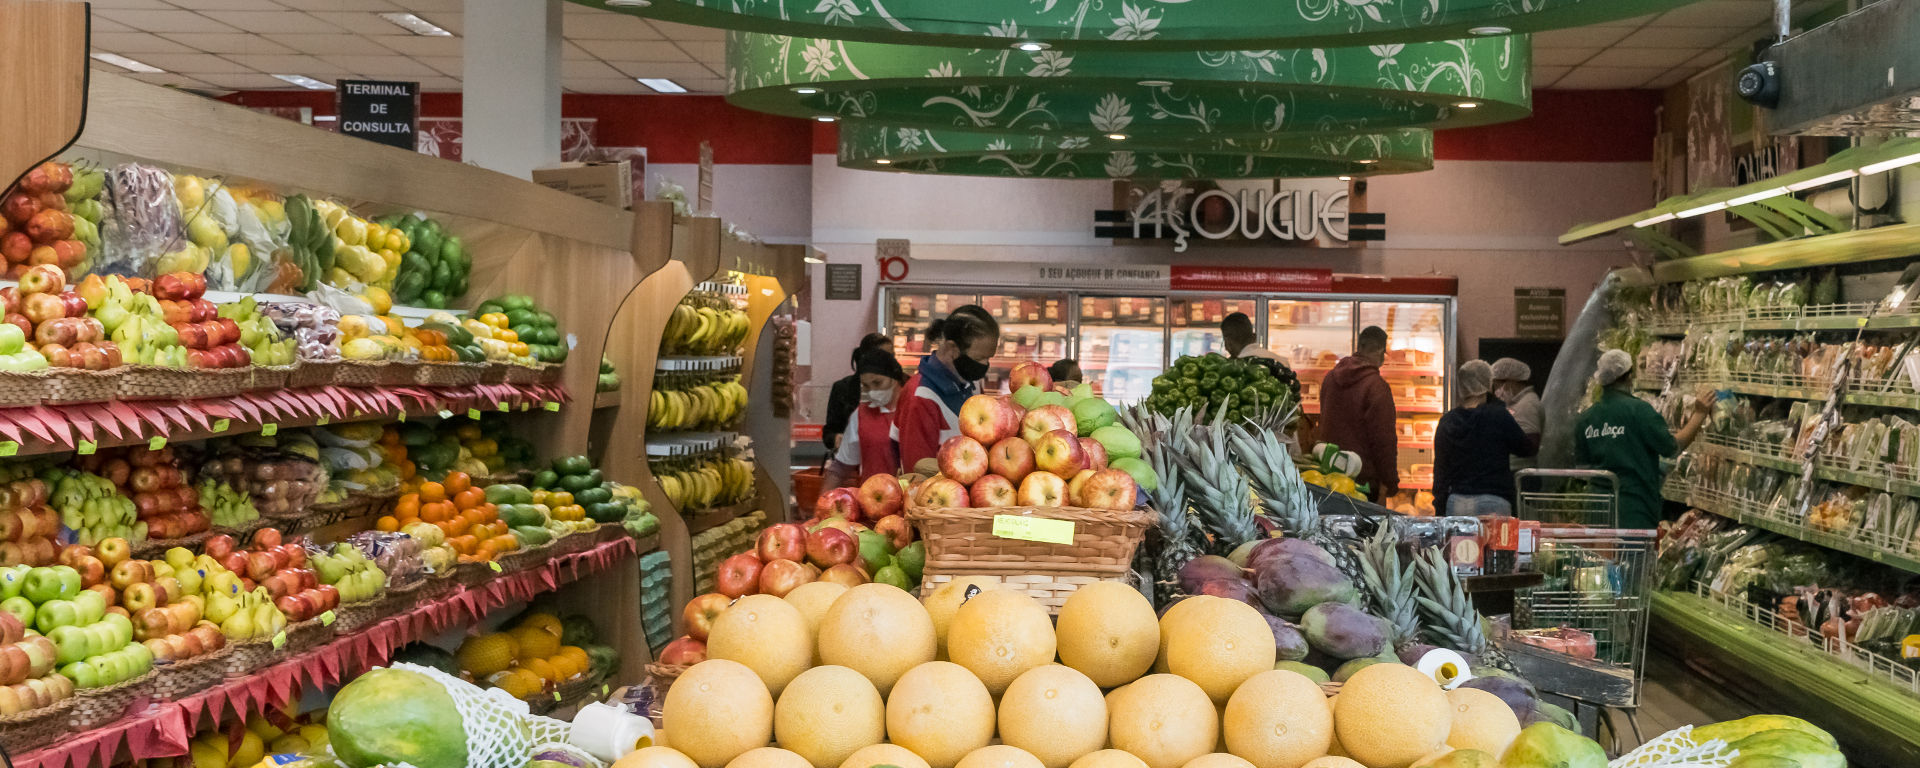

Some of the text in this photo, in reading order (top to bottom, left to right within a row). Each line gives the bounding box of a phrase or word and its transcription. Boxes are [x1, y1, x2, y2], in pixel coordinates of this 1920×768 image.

[345, 84, 410, 96] TERMINAL
[370, 103, 388, 114] DE
[343, 121, 411, 133] CONSULTA
[1130, 188, 1349, 253] AÇOUGUE
[878, 256, 909, 281] 10
[1040, 267, 1160, 281] O SEU AÇOUGUE DE CONFIANÇA
